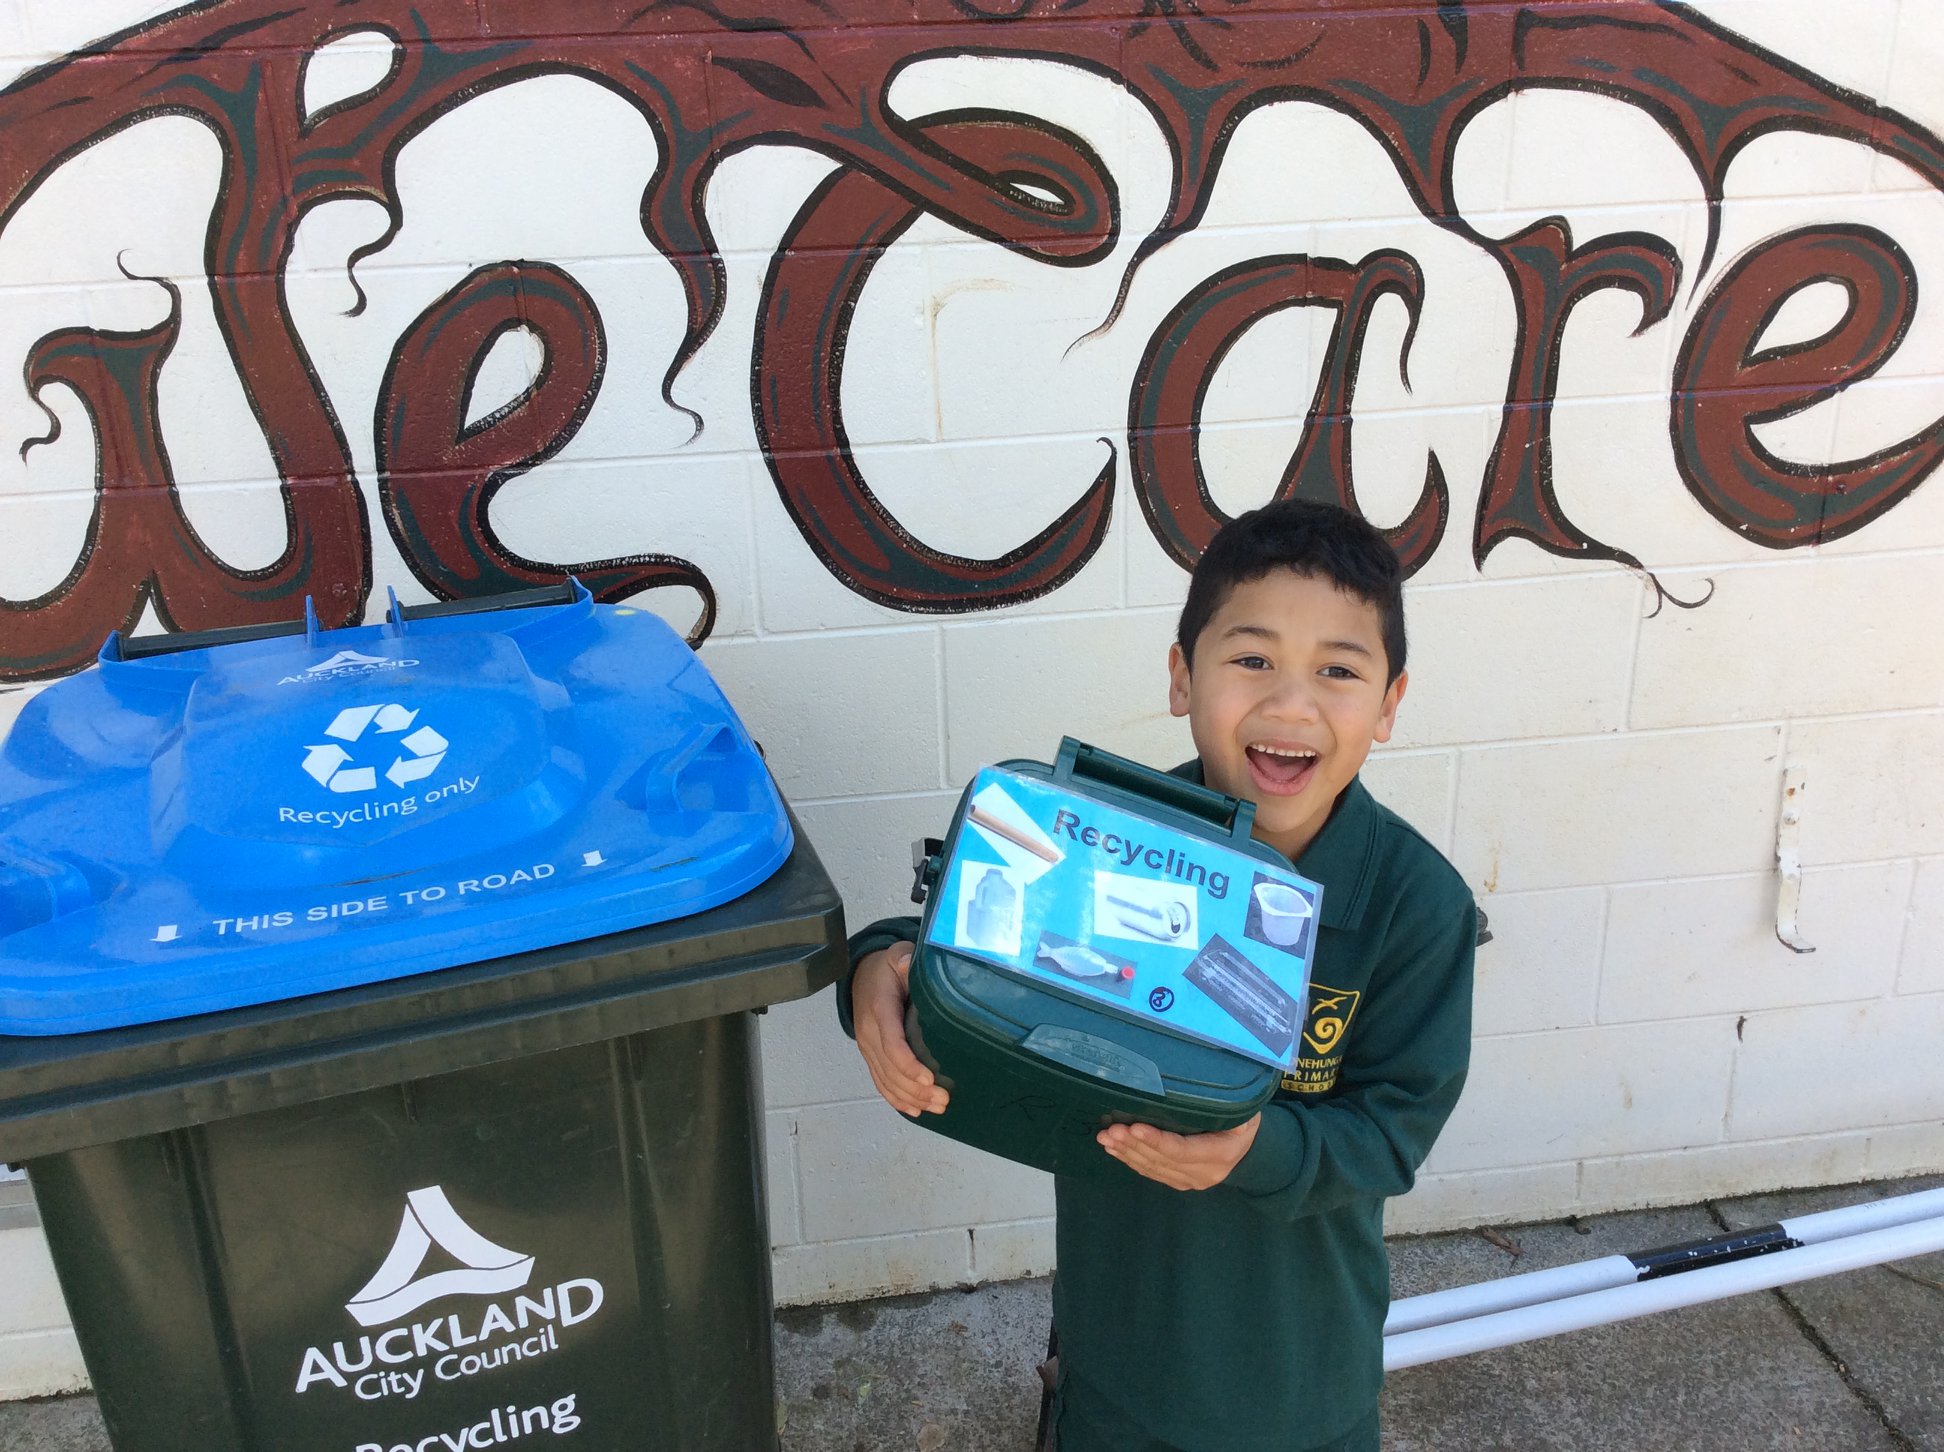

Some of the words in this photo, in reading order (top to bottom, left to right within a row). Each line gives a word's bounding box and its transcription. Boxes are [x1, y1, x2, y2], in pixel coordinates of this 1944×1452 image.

[753, 85, 1944, 617] Care
[277, 659, 420, 686] AUCKLAND
[279, 796, 418, 828] Recycling
[424, 776, 480, 803] only
[1053, 808, 1230, 900] Recycling
[212, 911, 293, 935] THIS
[306, 896, 388, 922] SIDE
[399, 885, 446, 906] TO
[457, 863, 555, 895] ROAD
[295, 1278, 604, 1393] AUCKLAND
[354, 1368, 424, 1400] City
[434, 1326, 559, 1381] Council
[355, 1393, 582, 1452] cycling
